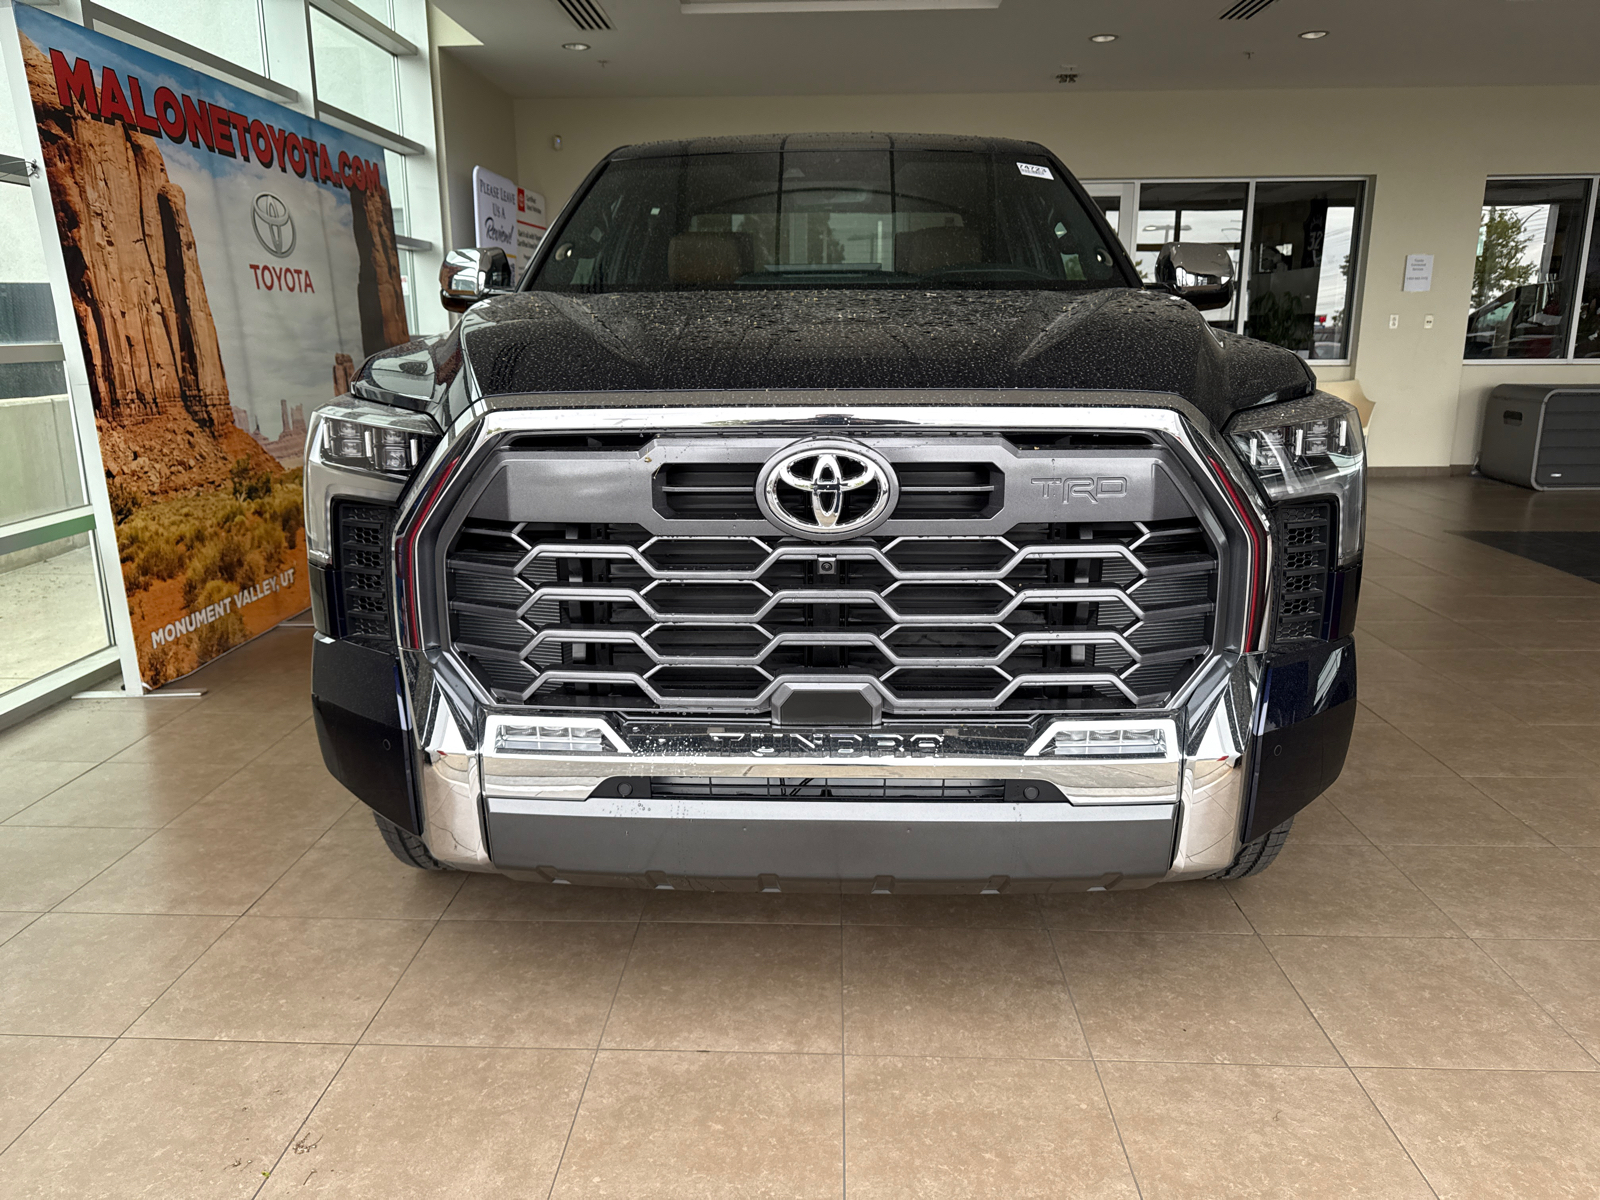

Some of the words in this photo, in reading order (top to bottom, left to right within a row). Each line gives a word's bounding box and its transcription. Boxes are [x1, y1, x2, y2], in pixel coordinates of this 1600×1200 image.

[48, 46, 382, 195] MALONETOYOTA.COM
[480, 178, 500, 200] PLEASE
[500, 187, 516, 206] LEAVE
[501, 206, 507, 220] A
[249, 263, 316, 294] TOYOTA
[1031, 476, 1128, 505] TRD
[151, 596, 233, 650] MONUMENT
[233, 575, 281, 610] VALLEY,
[279, 568, 296, 588] UT
[708, 732, 945, 759] TUNDRA
